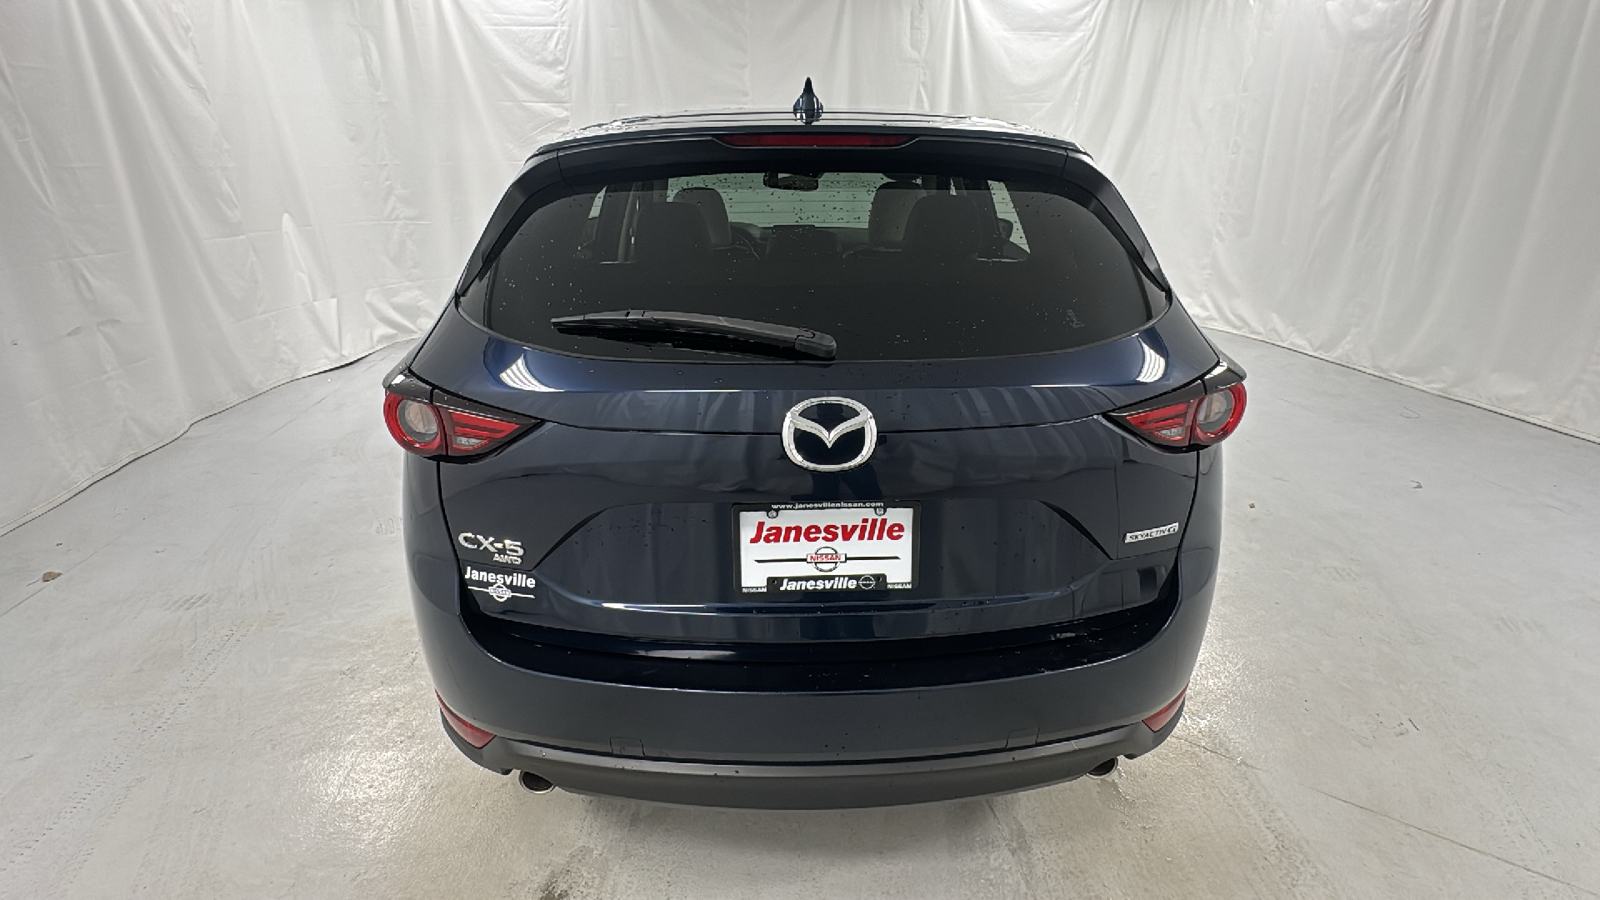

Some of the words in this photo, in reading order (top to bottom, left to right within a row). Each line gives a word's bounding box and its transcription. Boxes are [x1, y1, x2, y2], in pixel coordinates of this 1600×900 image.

[750, 518, 905, 543] Janesville
[458, 533, 524, 556] CX-5
[809, 554, 841, 562] NISSAN
[464, 566, 536, 588] Janesville
[779, 577, 857, 591] Janesville
